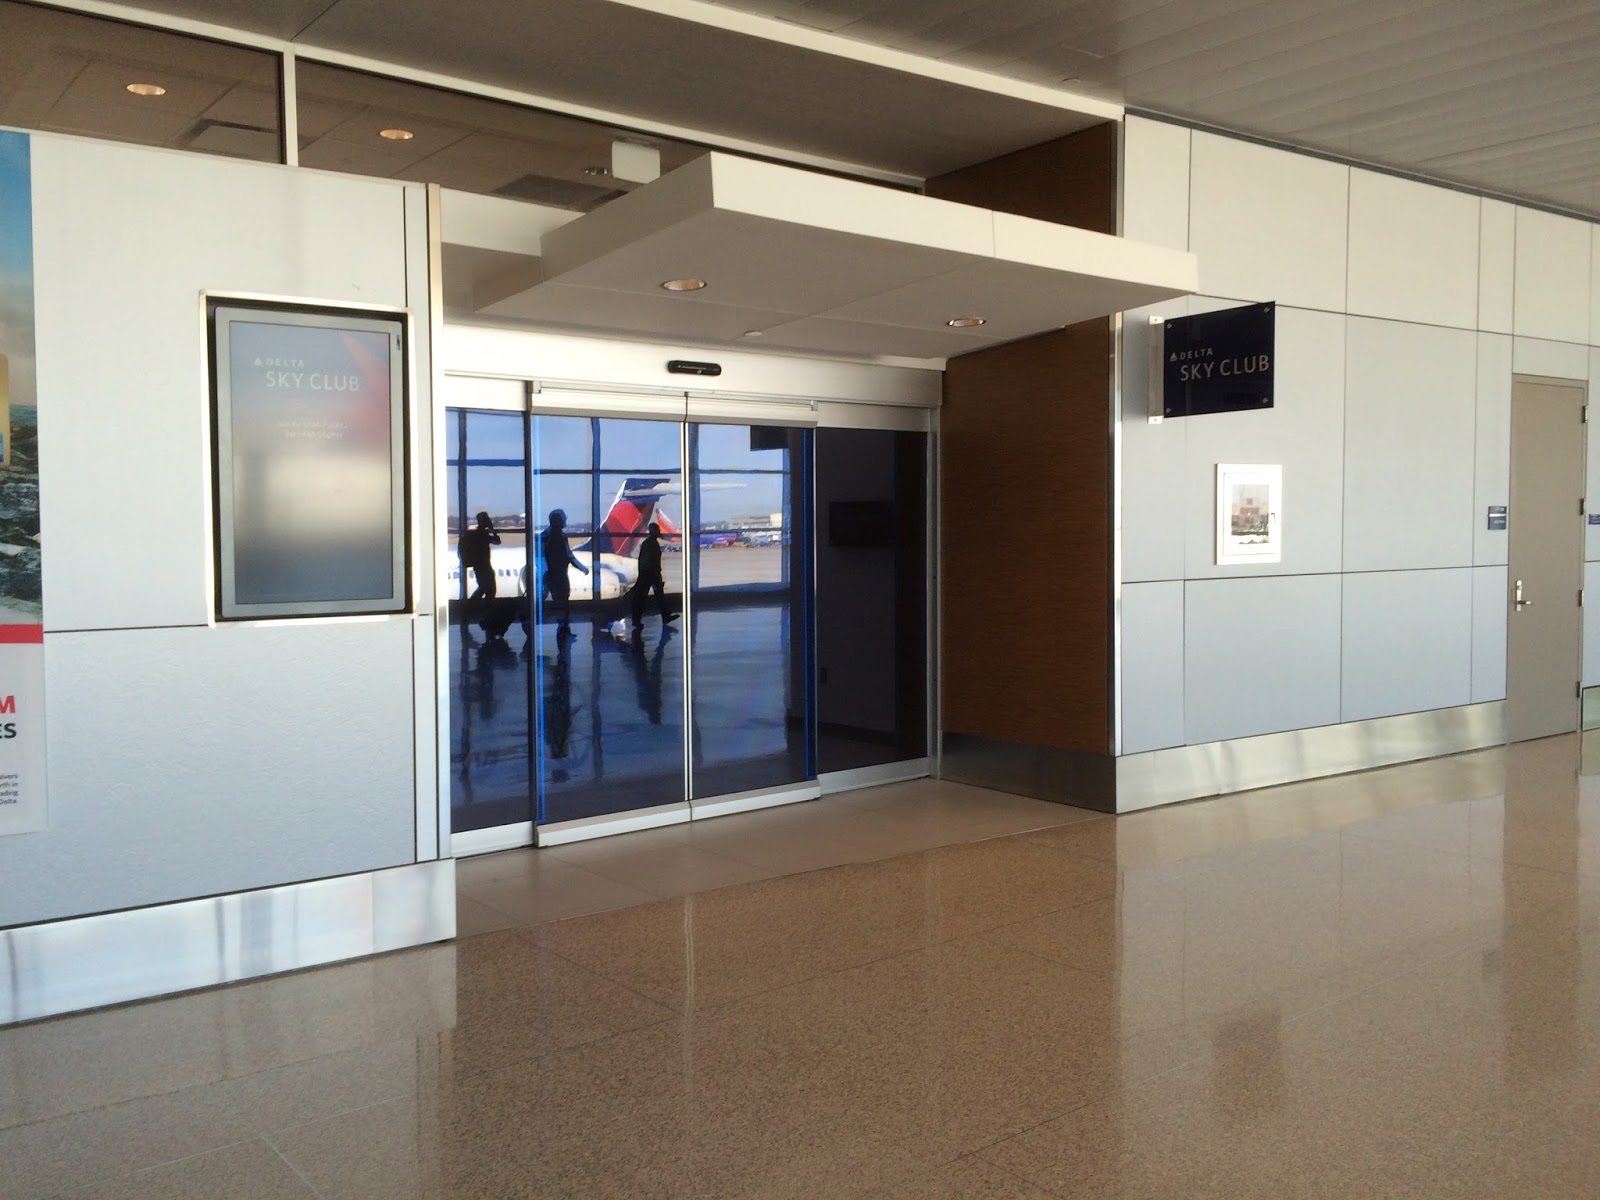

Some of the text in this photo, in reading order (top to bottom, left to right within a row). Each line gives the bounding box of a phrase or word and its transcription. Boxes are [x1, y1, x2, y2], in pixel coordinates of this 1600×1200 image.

[1180, 348, 1213, 360] DELTA
[266, 358, 304, 367] DELTA
[1180, 355, 1269, 381] SKY CLUB
[266, 371, 359, 391] SKY CLUB
[0, 723, 17, 739] S
